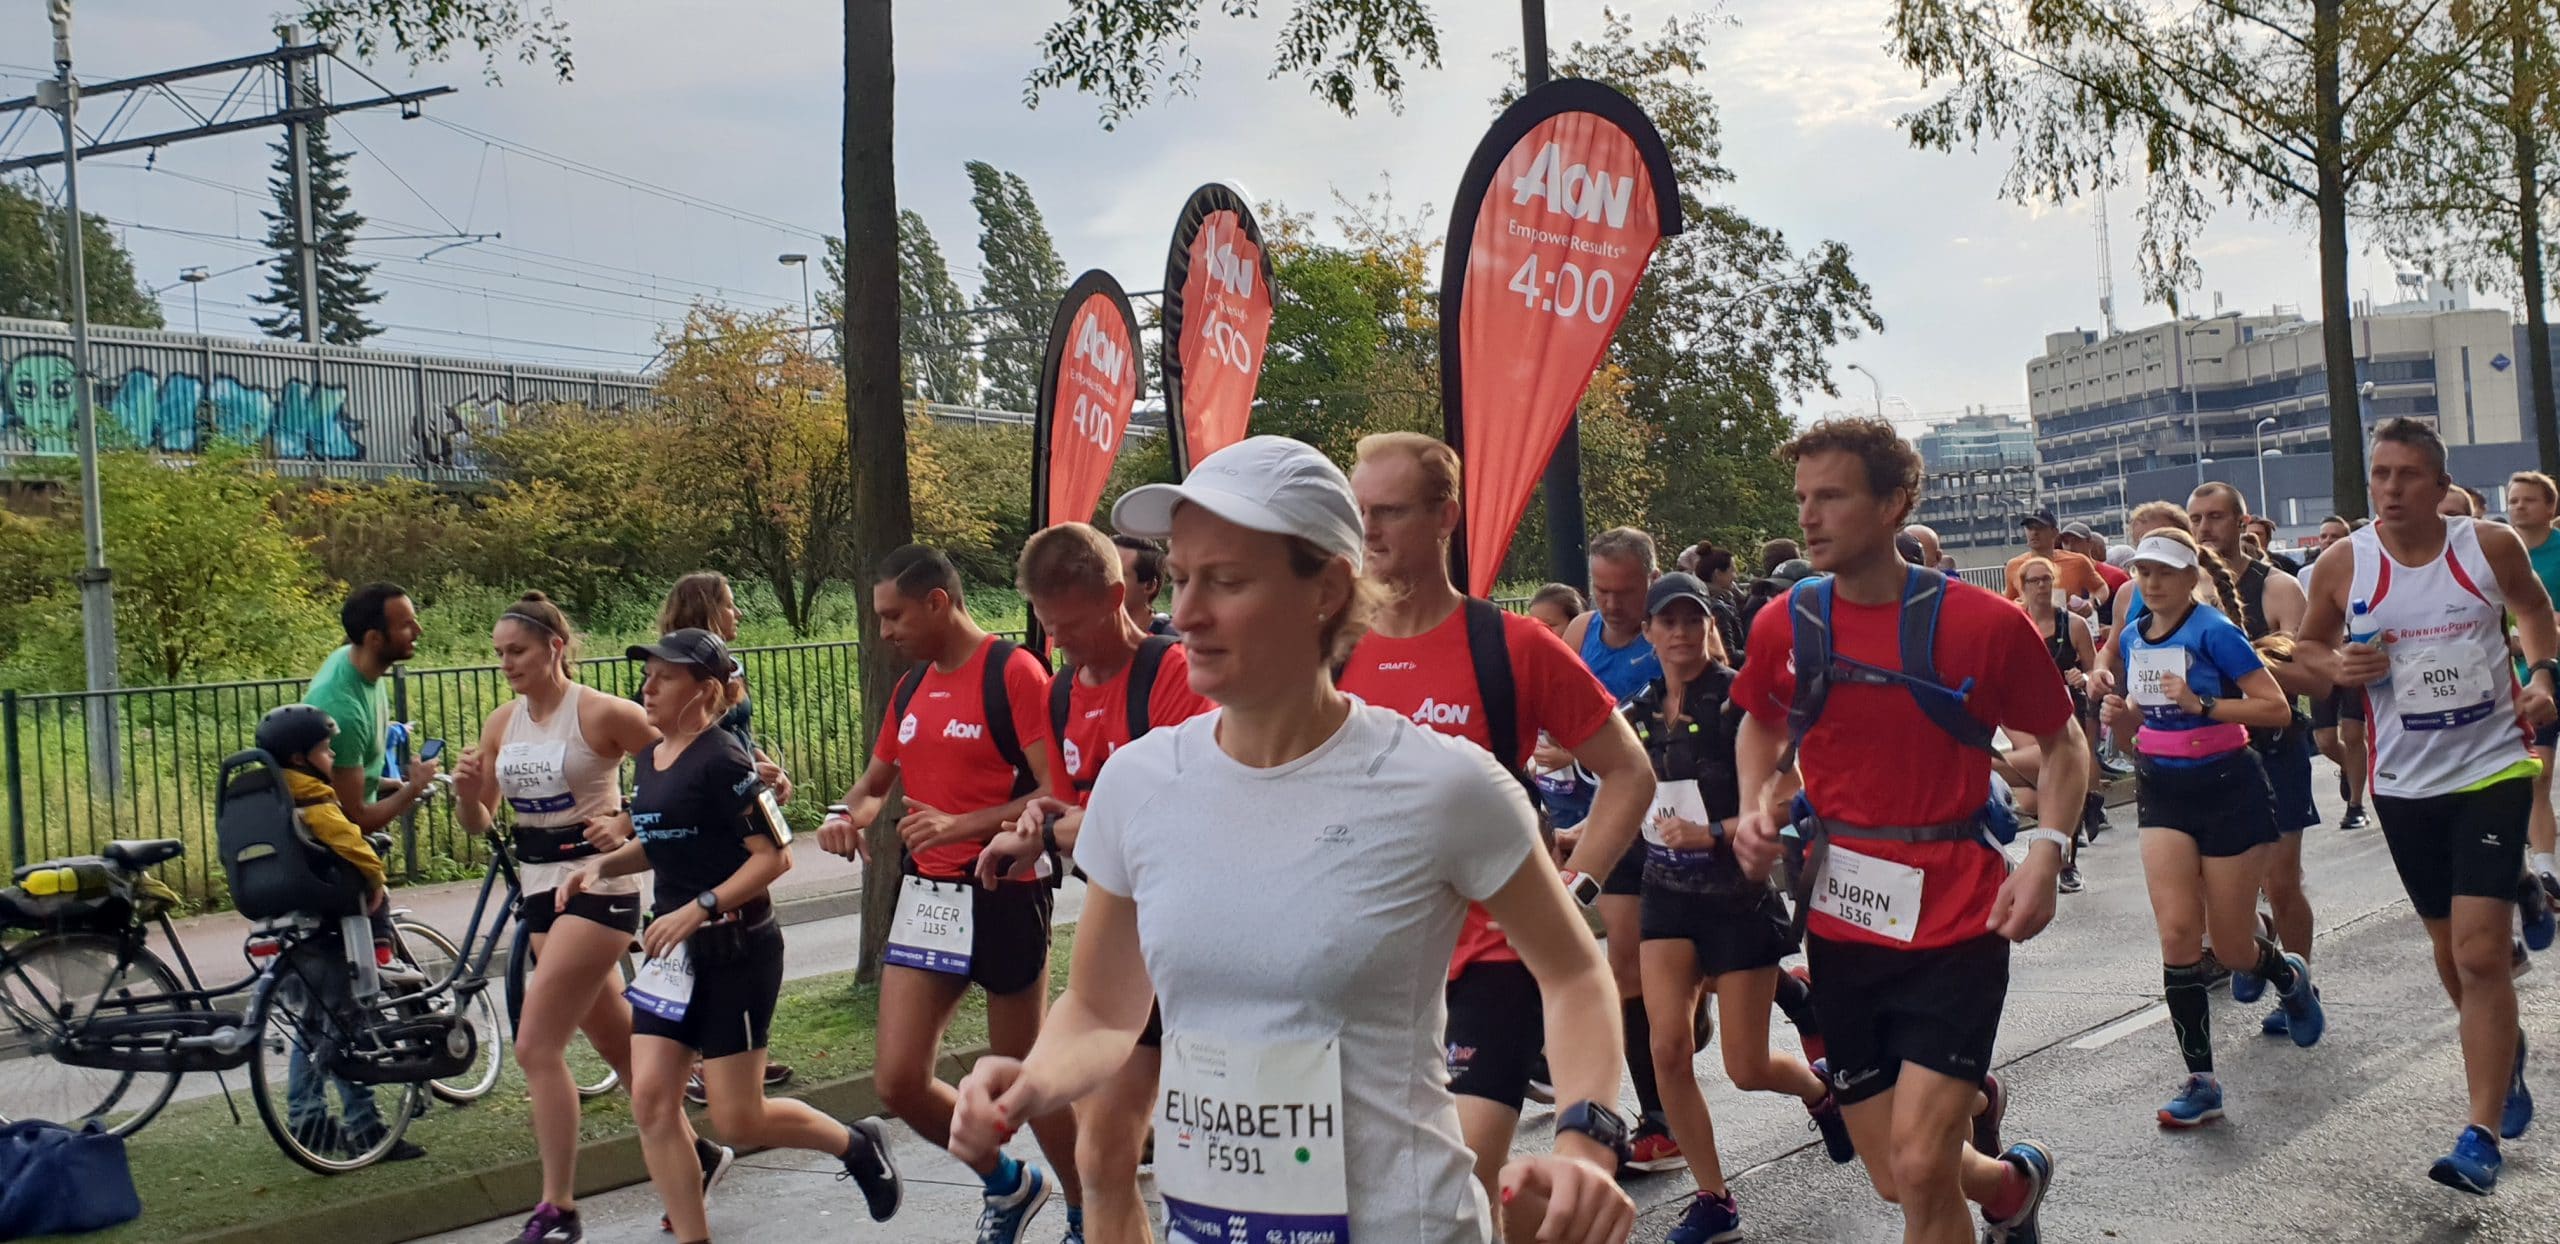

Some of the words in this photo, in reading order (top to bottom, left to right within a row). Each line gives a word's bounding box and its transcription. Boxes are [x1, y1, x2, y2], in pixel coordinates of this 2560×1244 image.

[1512, 141, 1634, 229] AON
[1508, 219, 1569, 246] Empowe
[1508, 254, 1614, 323] 4:00
[2423, 667, 2459, 685] RON
[2432, 685, 2457, 698] 363
[1412, 698, 1470, 725] AON
[943, 719, 983, 739] AON
[503, 761, 551, 776] MASCHA
[1828, 877, 1890, 912] BJØRN
[916, 903, 960, 922] PACER
[1839, 903, 1872, 926] 1536
[922, 921, 947, 936] 1135
[1165, 1089, 1333, 1139] ELISABETH
[1208, 1145, 1265, 1175] F591
